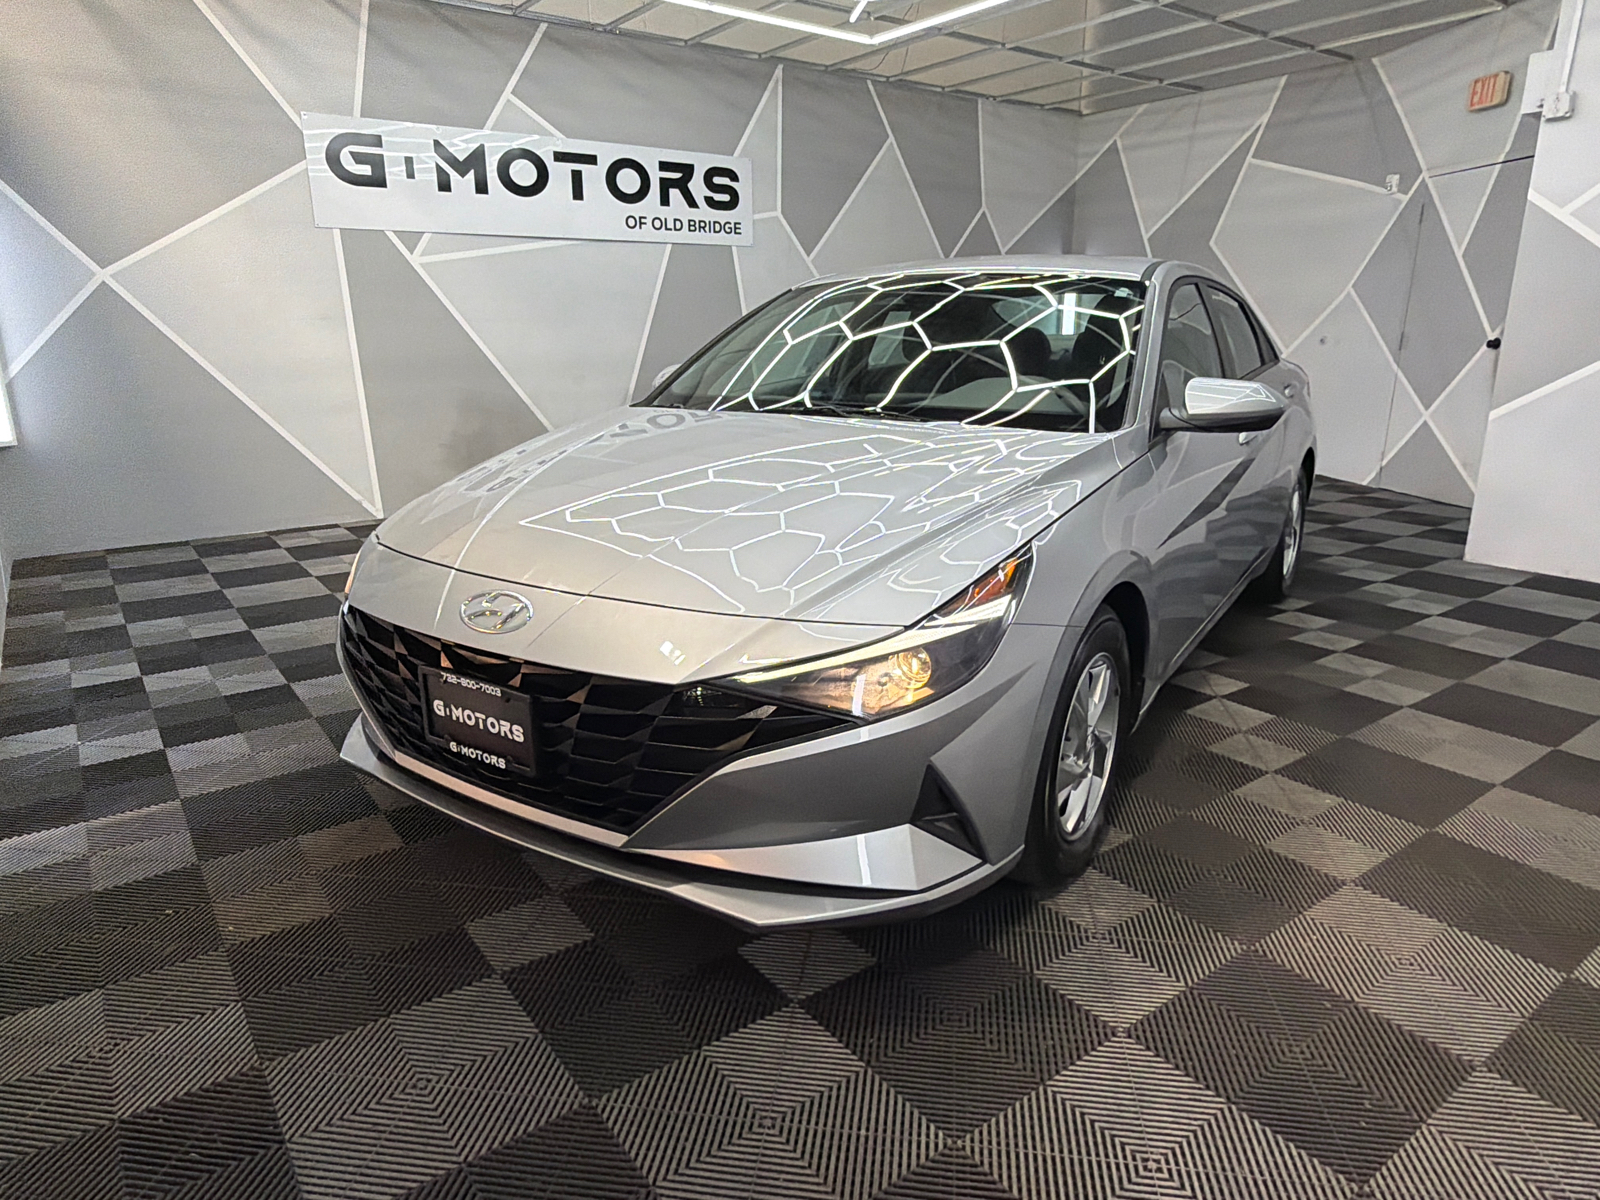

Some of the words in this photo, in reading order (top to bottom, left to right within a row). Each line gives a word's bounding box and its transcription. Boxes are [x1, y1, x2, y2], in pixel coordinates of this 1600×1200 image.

[1469, 73, 1500, 107] EXIT
[625, 215, 648, 230] OF
[651, 217, 684, 232] OLD
[687, 219, 742, 235] BRIDGE
